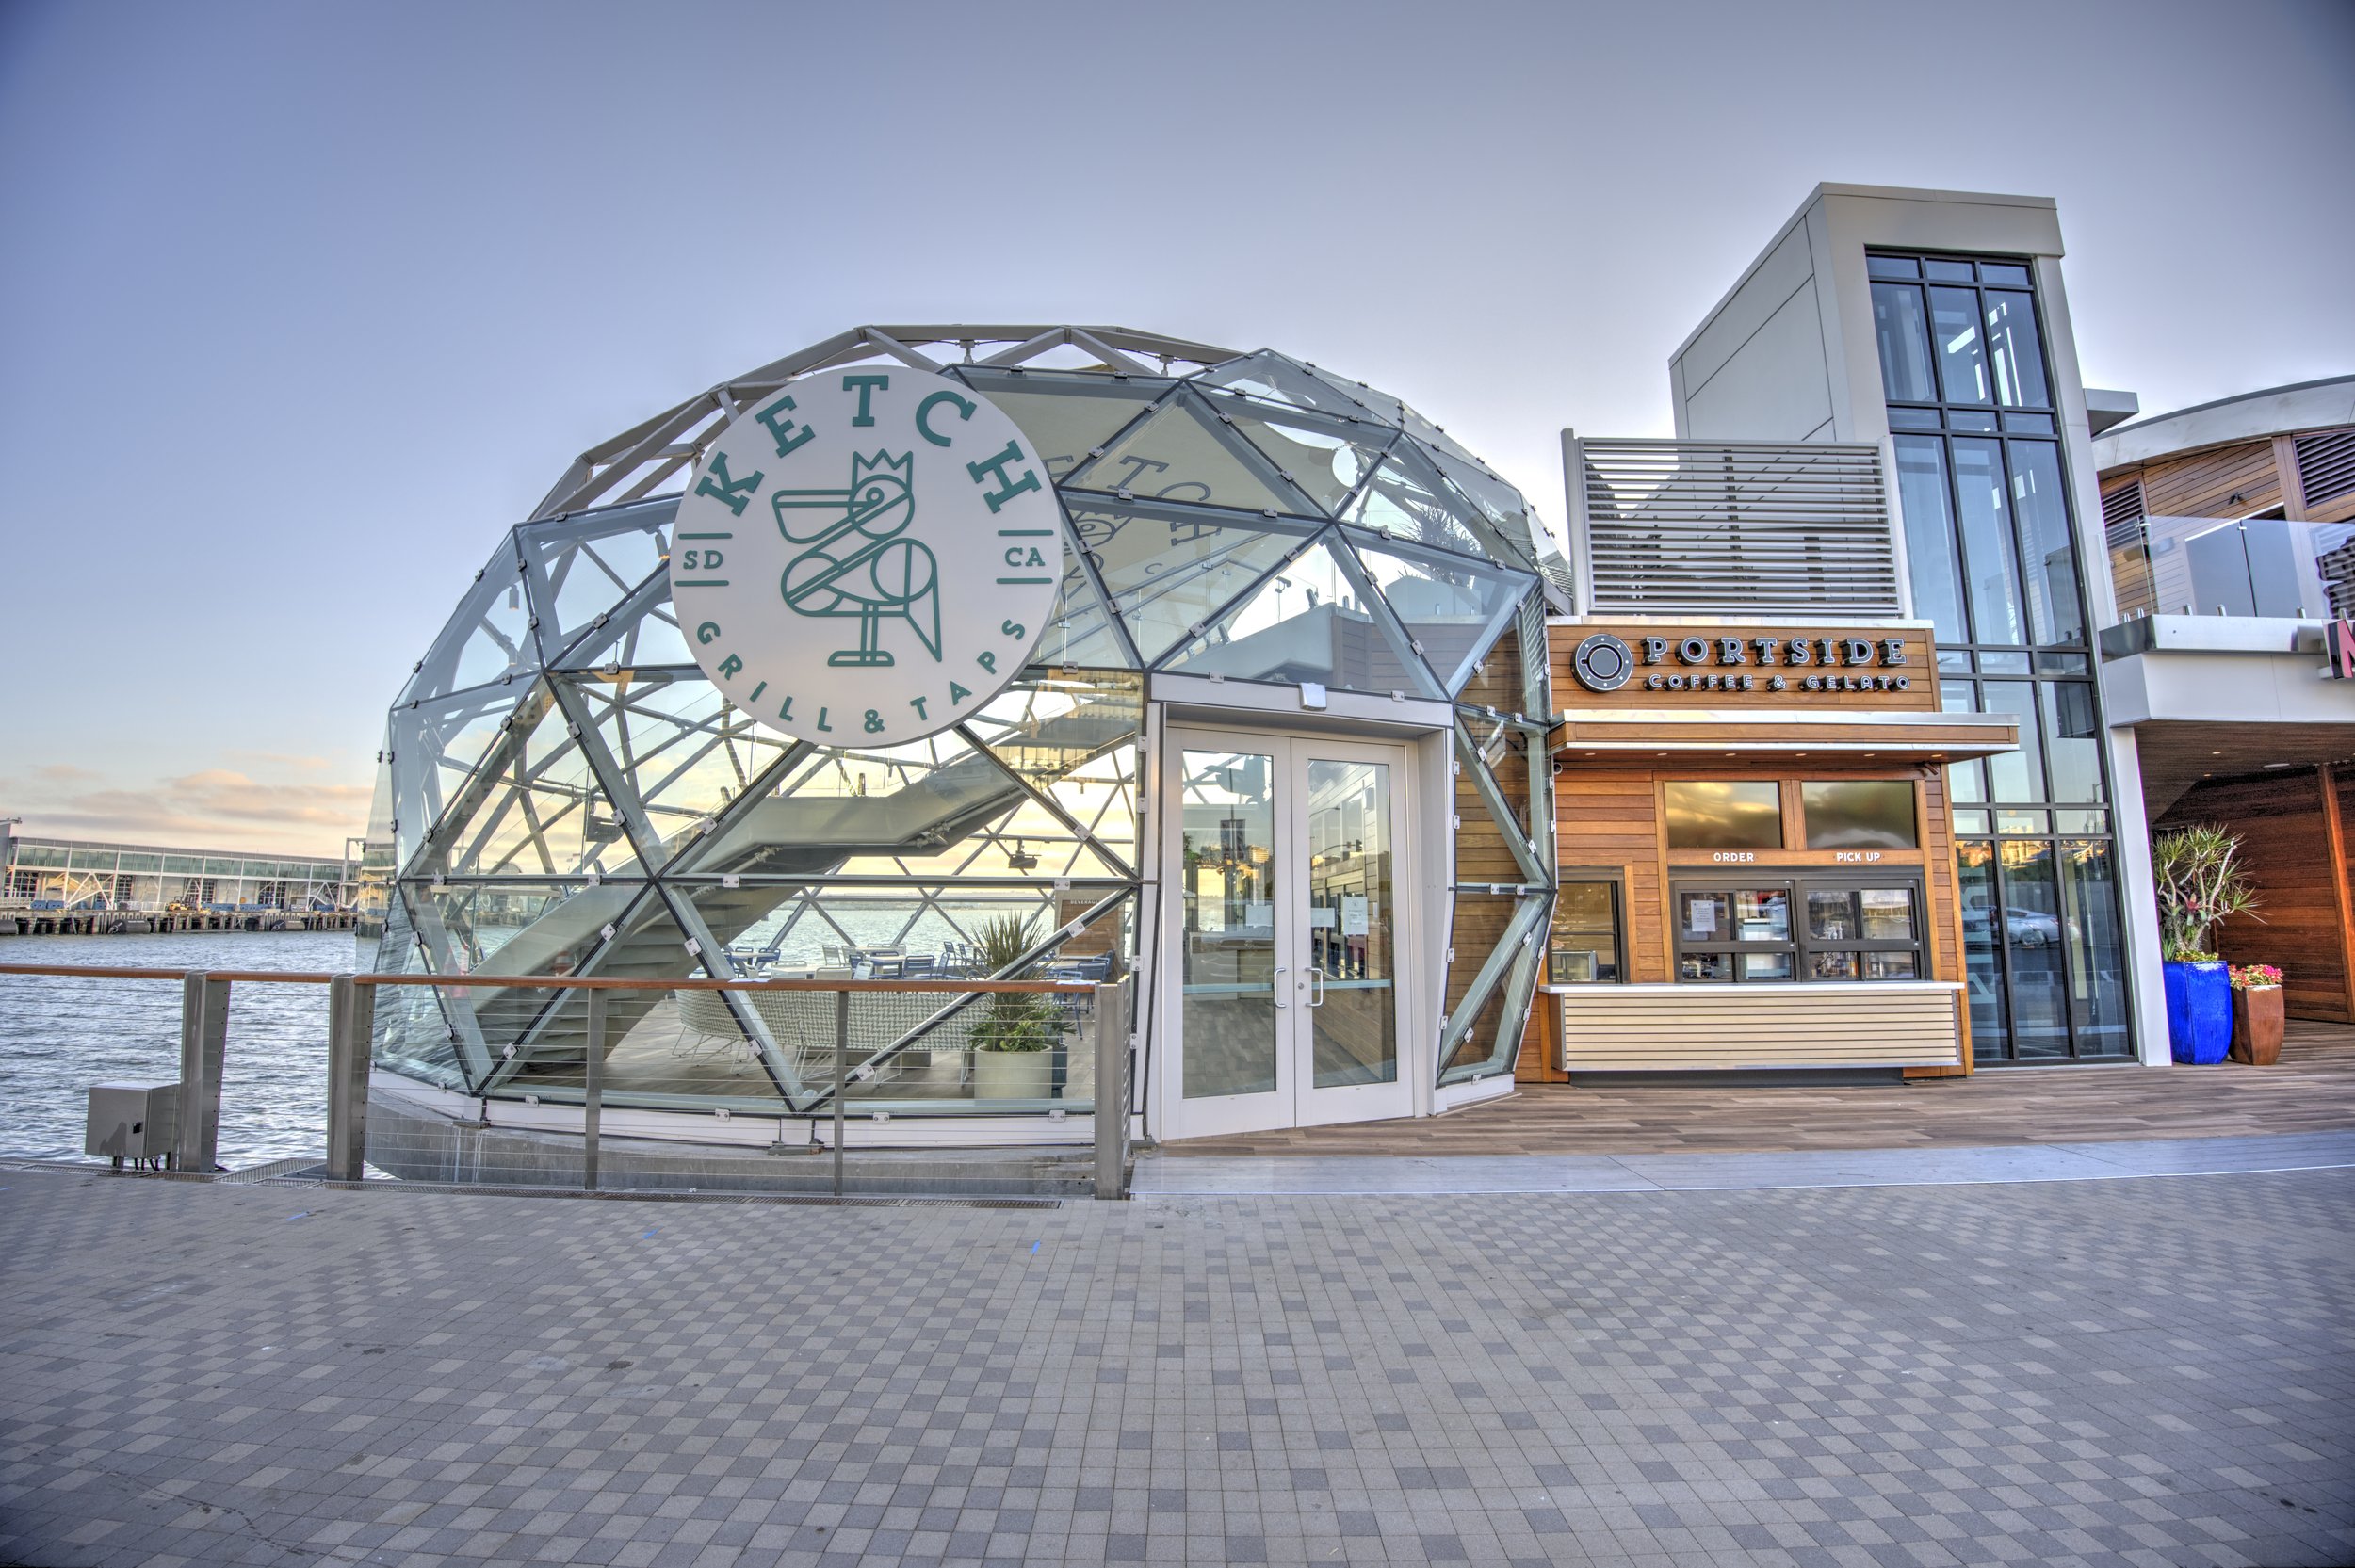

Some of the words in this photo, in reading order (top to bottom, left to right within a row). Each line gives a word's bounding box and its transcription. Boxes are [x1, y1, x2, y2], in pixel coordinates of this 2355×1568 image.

[694, 375, 1042, 516] KETCH
[683, 550, 723, 570] SD
[1005, 547, 1046, 567] CA
[1643, 636, 1908, 665] PORTSIDE
[696, 621, 833, 733] GRILL
[864, 708, 885, 734] &
[910, 619, 1026, 722] TAPS
[1647, 673, 1754, 689] COFFEE
[1770, 674, 1787, 690] &
[1803, 674, 1910, 690] GELATO
[1713, 852, 1754, 862] ORDER
[1836, 852, 1861, 862] PICK
[1866, 852, 1881, 862] UP
